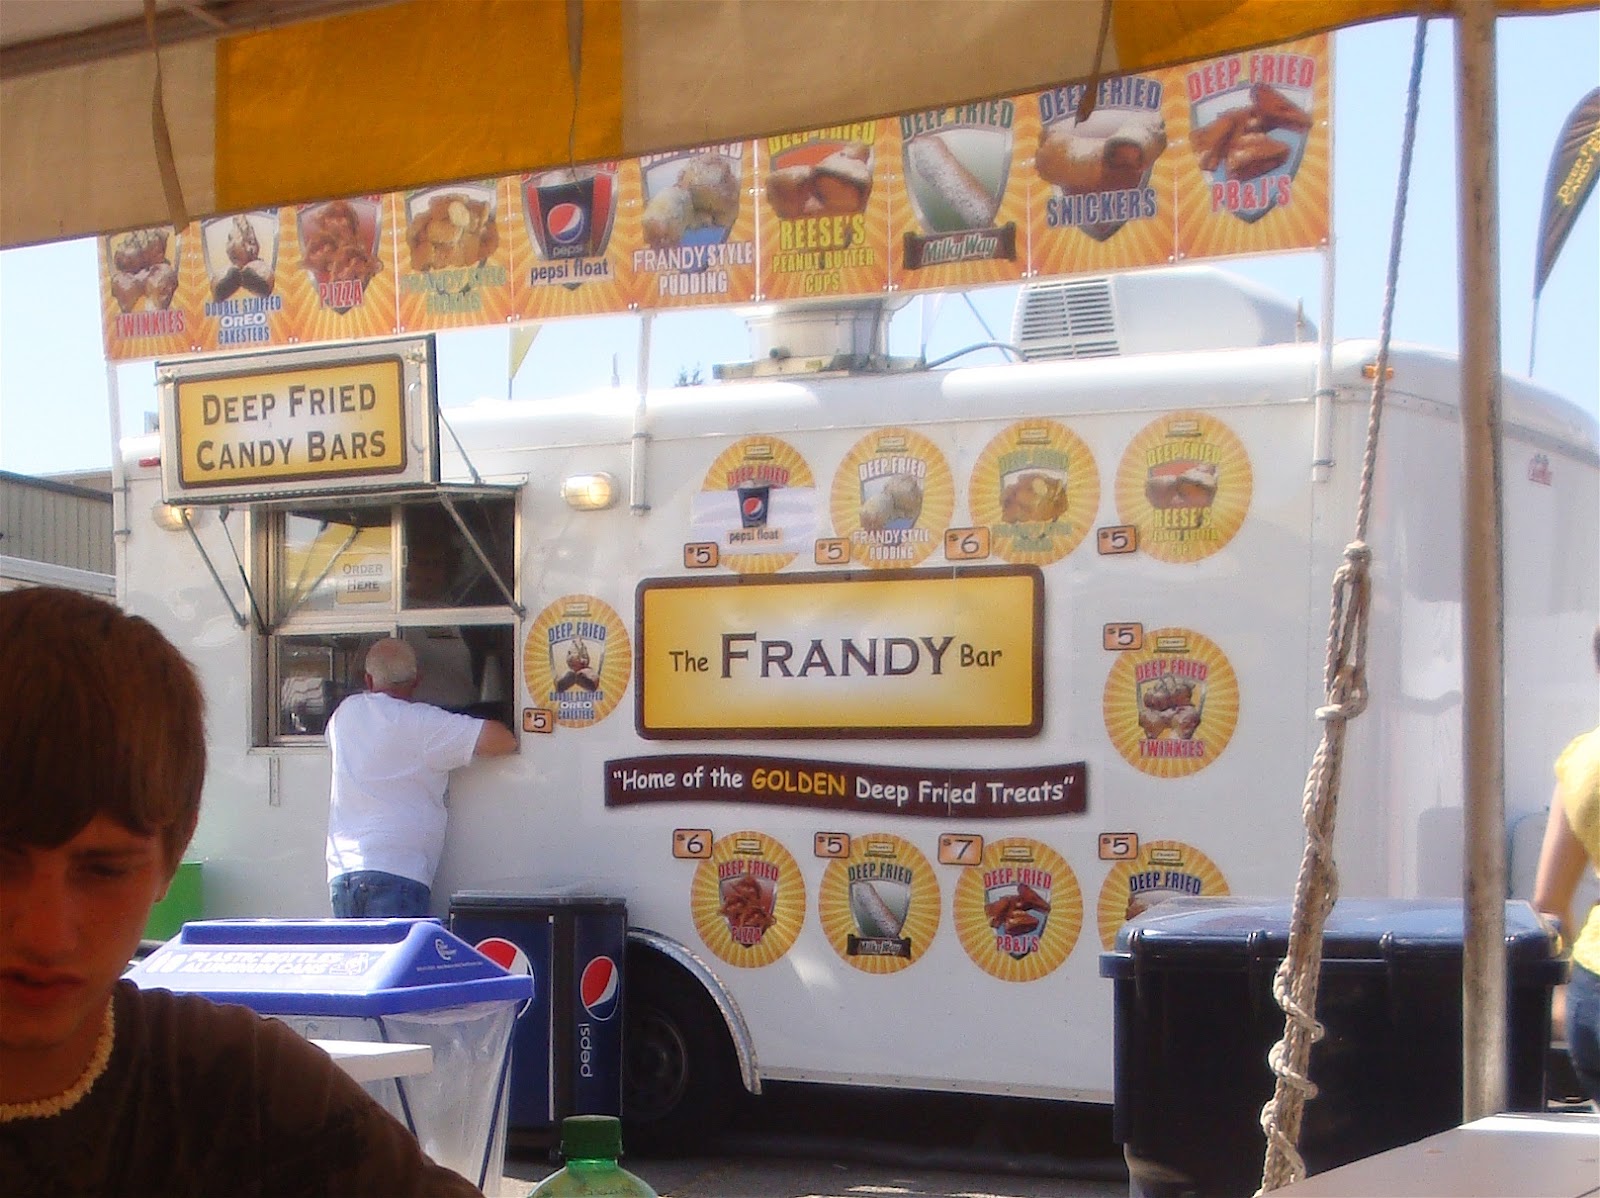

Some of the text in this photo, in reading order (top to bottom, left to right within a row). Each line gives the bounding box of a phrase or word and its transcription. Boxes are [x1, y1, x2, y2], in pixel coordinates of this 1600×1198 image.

[1187, 53, 1315, 99] DEEP FRIED
[1098, 76, 1163, 112] FRIED
[955, 99, 1014, 130] FRIED
[1211, 175, 1291, 212] PB&J'S
[1047, 188, 1157, 227] SNICKERS
[779, 214, 865, 252] REESE'S
[633, 241, 753, 273] FRANDY STYLE
[773, 249, 874, 273] PEANUT BUTTER
[531, 257, 609, 286] pepsi float
[805, 274, 840, 292] CUPS
[319, 279, 363, 309] PIZZA
[659, 273, 728, 296] PUDDING
[205, 296, 282, 317] DOUBLE STUFFED
[115, 311, 185, 337] TWINKIES
[221, 312, 266, 328] OREO
[218, 326, 270, 344] CAKESTERS
[202, 383, 376, 426] DEEP FRIED
[197, 430, 386, 471] CANDY BARS
[858, 456, 926, 481] DEEP FRIED
[343, 563, 383, 575] ORDER
[548, 621, 607, 643] DEEP FRIED
[669, 631, 1002, 679] The FRANDY Bar
[1135, 657, 1208, 683] DEEP FRIED
[560, 700, 592, 710] OREO
[1139, 739, 1206, 758] TWINKIES
[682, 766, 704, 788] of
[710, 766, 743, 789] the
[752, 767, 846, 796] GOLDEN
[855, 776, 908, 807] Deep
[918, 780, 976, 805] Fried
[677, 834, 704, 854] $6
[818, 836, 843, 854] $5
[1102, 837, 1130, 856] $5
[719, 860, 779, 881] DEEP FRIED
[849, 863, 913, 884] DEEP FRIED
[984, 867, 1052, 890] DEEP FRIED
[1129, 871, 1202, 896] DEEP FRIED
[996, 934, 1039, 953] PB&J'S
[578, 1023, 593, 1078] pepsi
